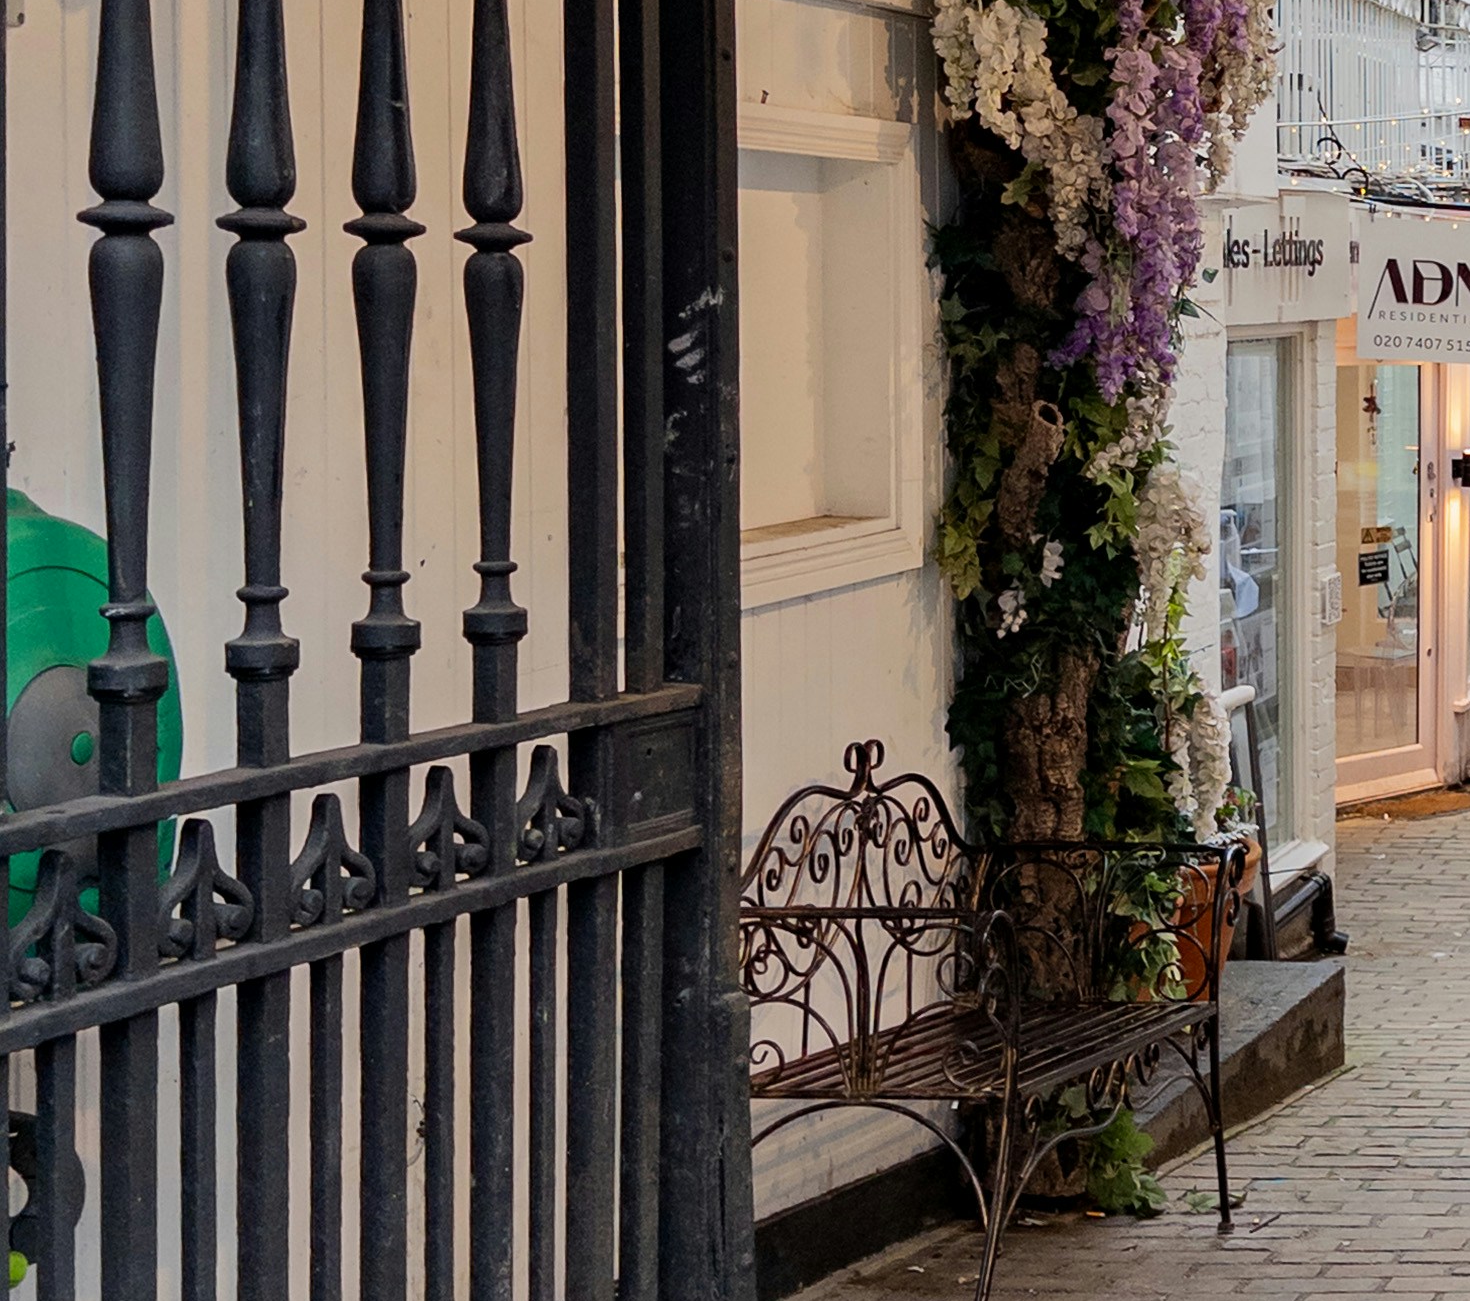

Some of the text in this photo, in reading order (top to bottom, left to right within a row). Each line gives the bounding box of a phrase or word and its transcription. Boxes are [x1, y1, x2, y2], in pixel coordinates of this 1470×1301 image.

[1264, 229, 1324, 276] Lettings
[1373, 334, 1402, 348] 020
[1406, 336, 1442, 350] 7407
